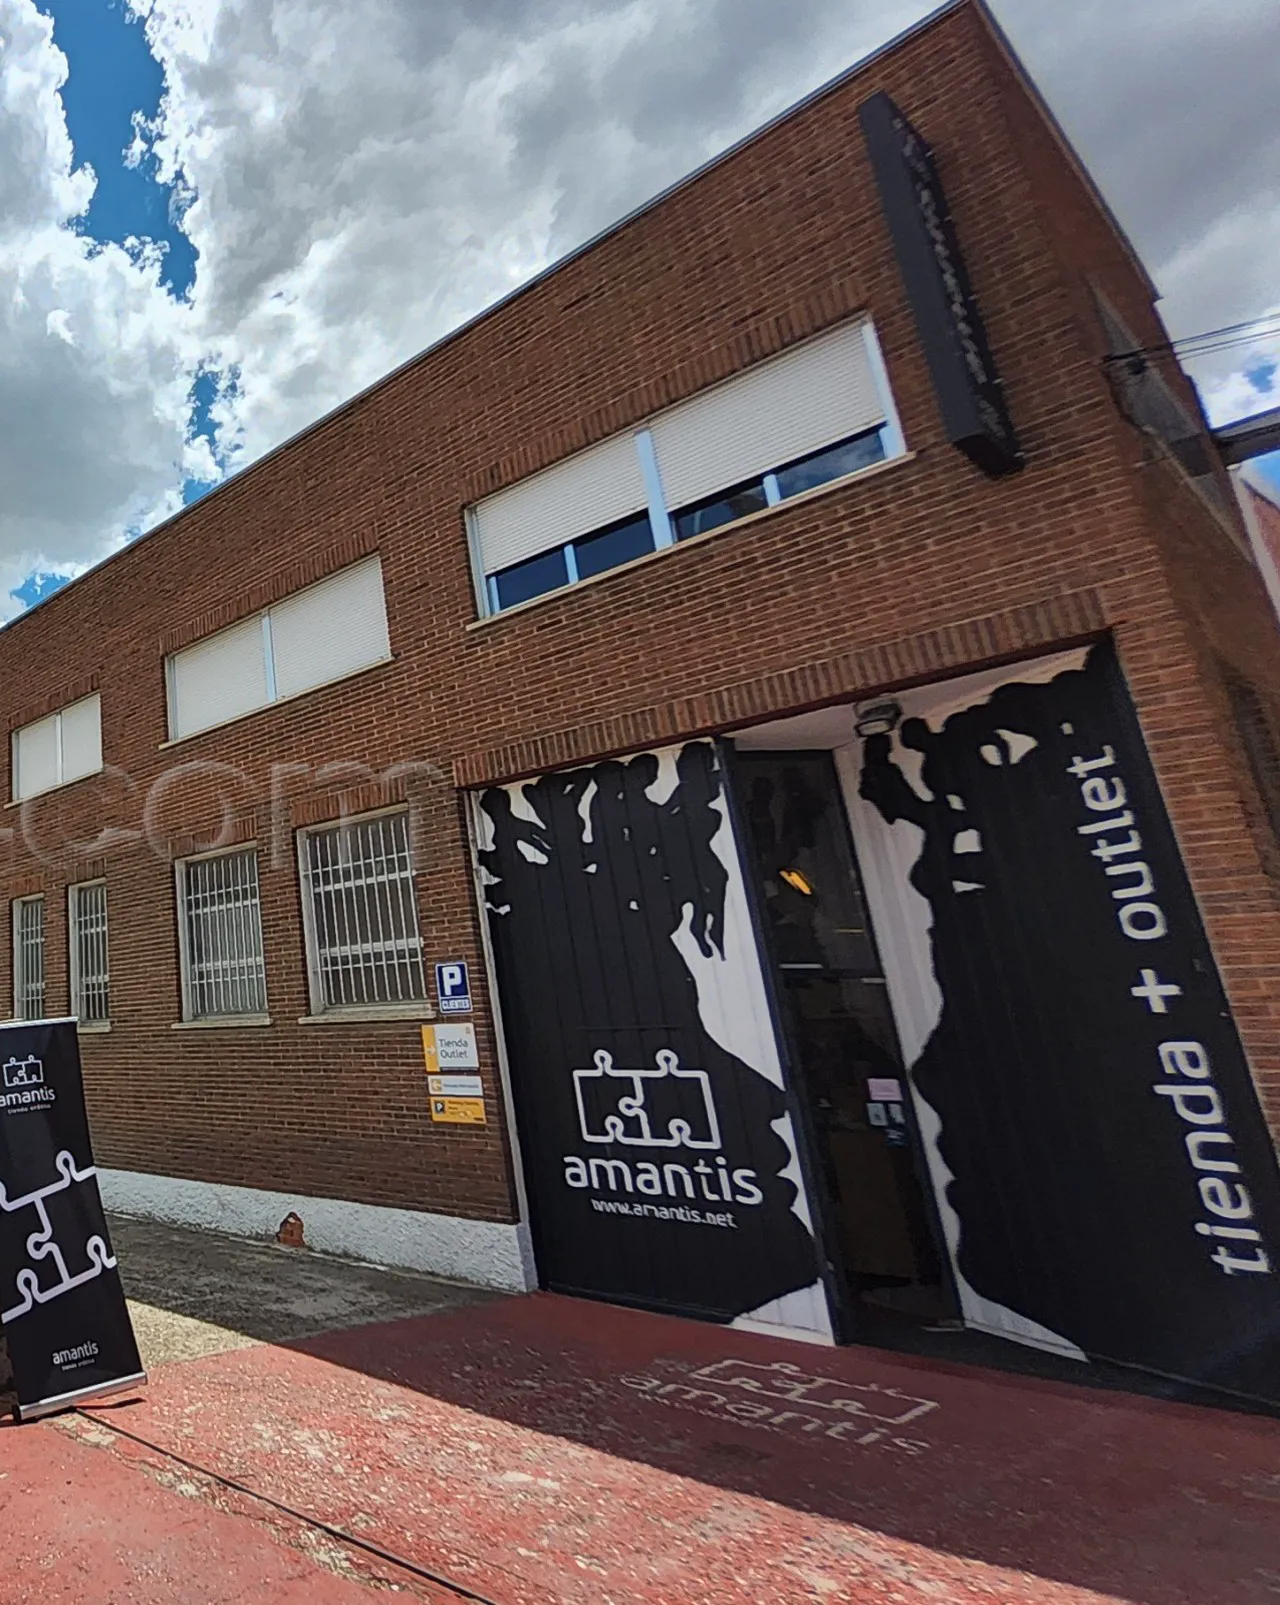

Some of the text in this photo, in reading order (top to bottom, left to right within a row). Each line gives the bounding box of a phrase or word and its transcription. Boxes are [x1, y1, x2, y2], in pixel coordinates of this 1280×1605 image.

[442, 966, 462, 996] P
[1066, 742, 1270, 1277] tienda + outlet
[438, 1039, 468, 1048] Tienda
[440, 1049, 468, 1059] Outlet
[563, 1156, 764, 1205] amantis
[590, 1198, 739, 1229] www.amantis.net
[52, 1340, 99, 1365] amantis
[619, 1376, 931, 1455] amantis
